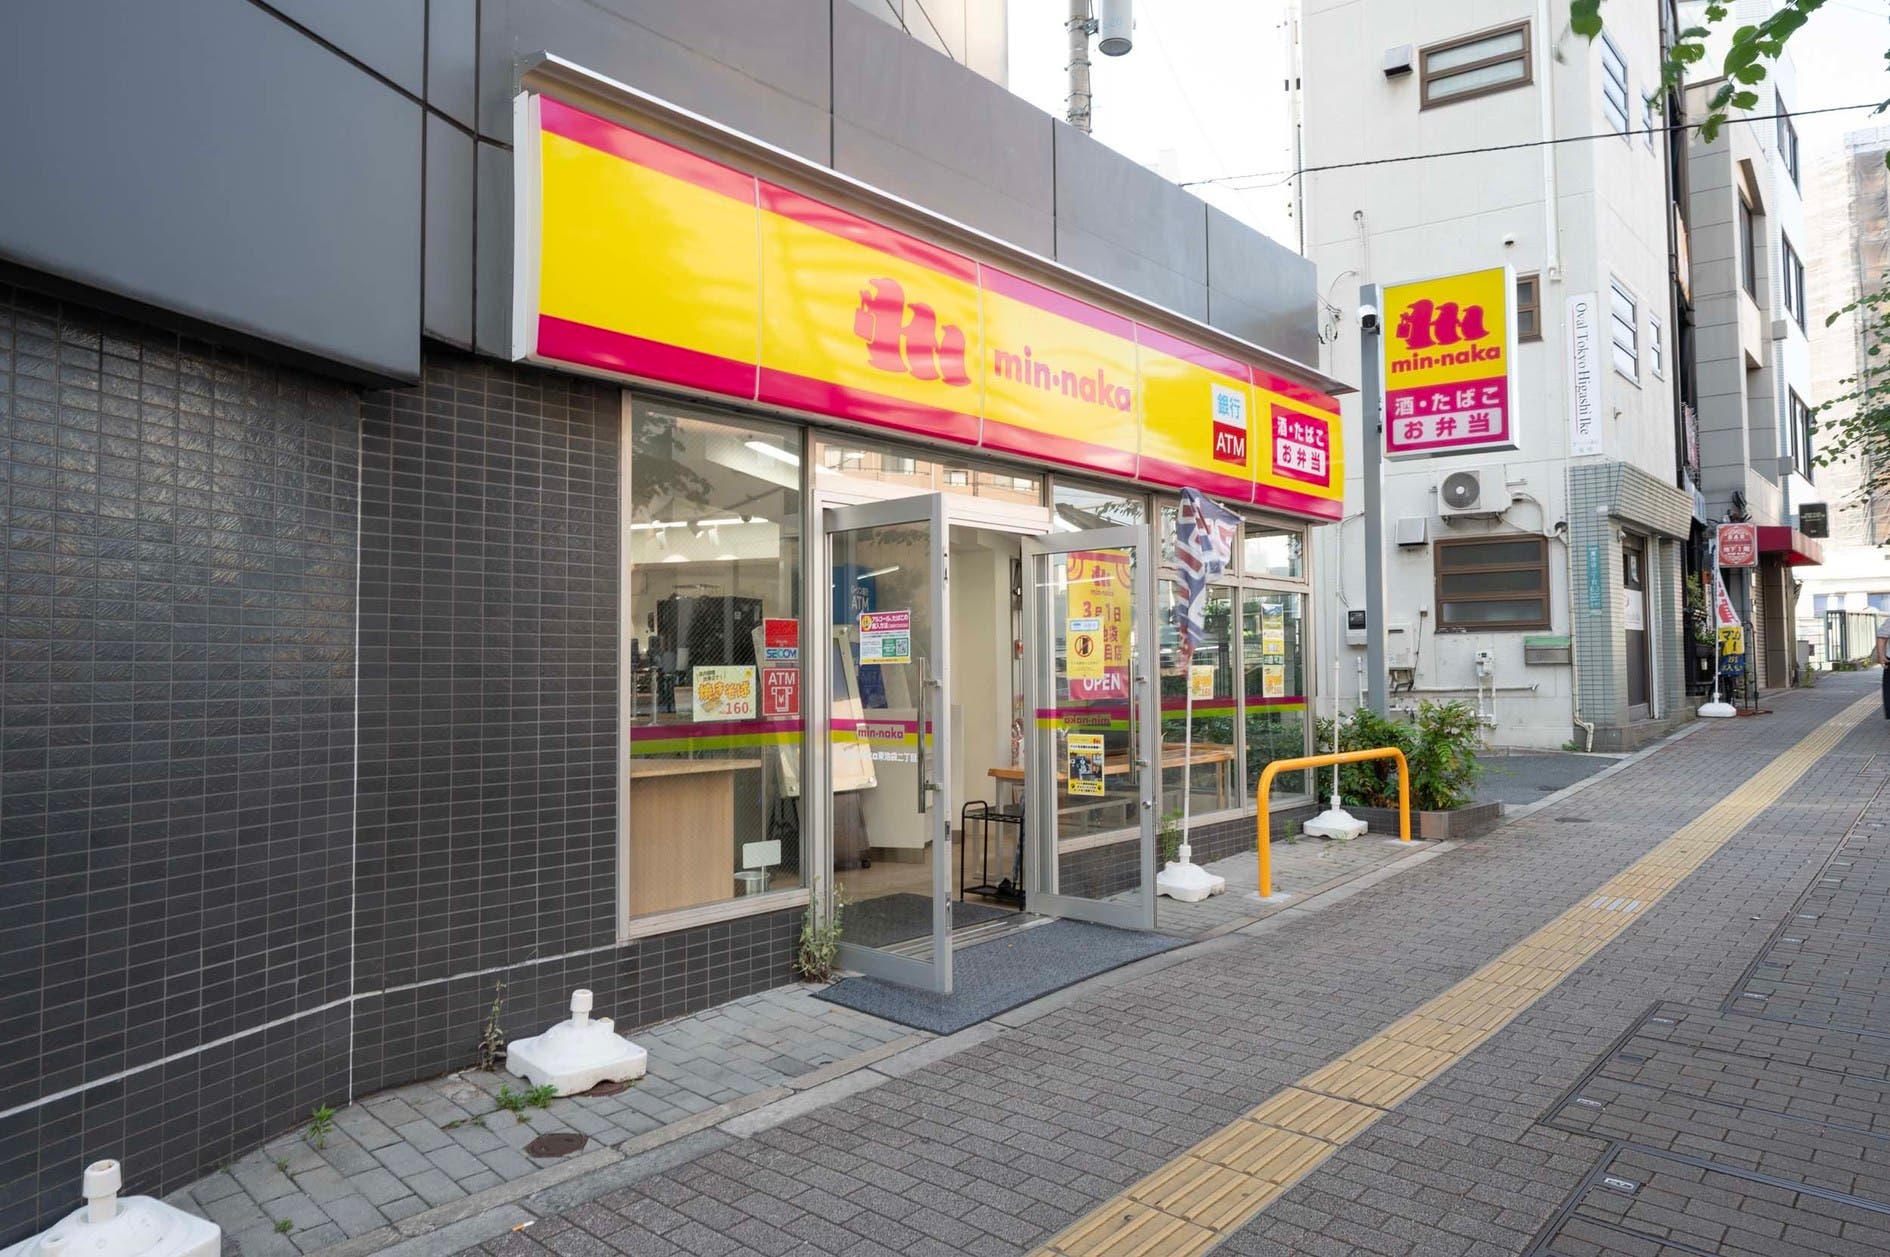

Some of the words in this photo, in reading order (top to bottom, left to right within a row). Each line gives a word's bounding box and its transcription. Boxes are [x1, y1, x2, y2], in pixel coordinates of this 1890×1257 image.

[1575, 302, 1588, 329] Oval
[1576, 332, 1589, 369] Tokyo
[1217, 393, 1241, 419] 銀行
[1395, 387, 1500, 416] 酒・たばこ
[1578, 370, 1591, 418] Higashi
[1277, 415, 1325, 447] 酒・たばこ
[1404, 412, 1490, 440] お弁当
[1216, 431, 1245, 458] ATM
[1282, 443, 1321, 473] お弁当
[851, 596, 870, 611] ATM
[766, 648, 797, 659] SECOM
[768, 672, 796, 686] ATM
[1083, 673, 1121, 691] OPEN
[726, 702, 749, 715] 160
